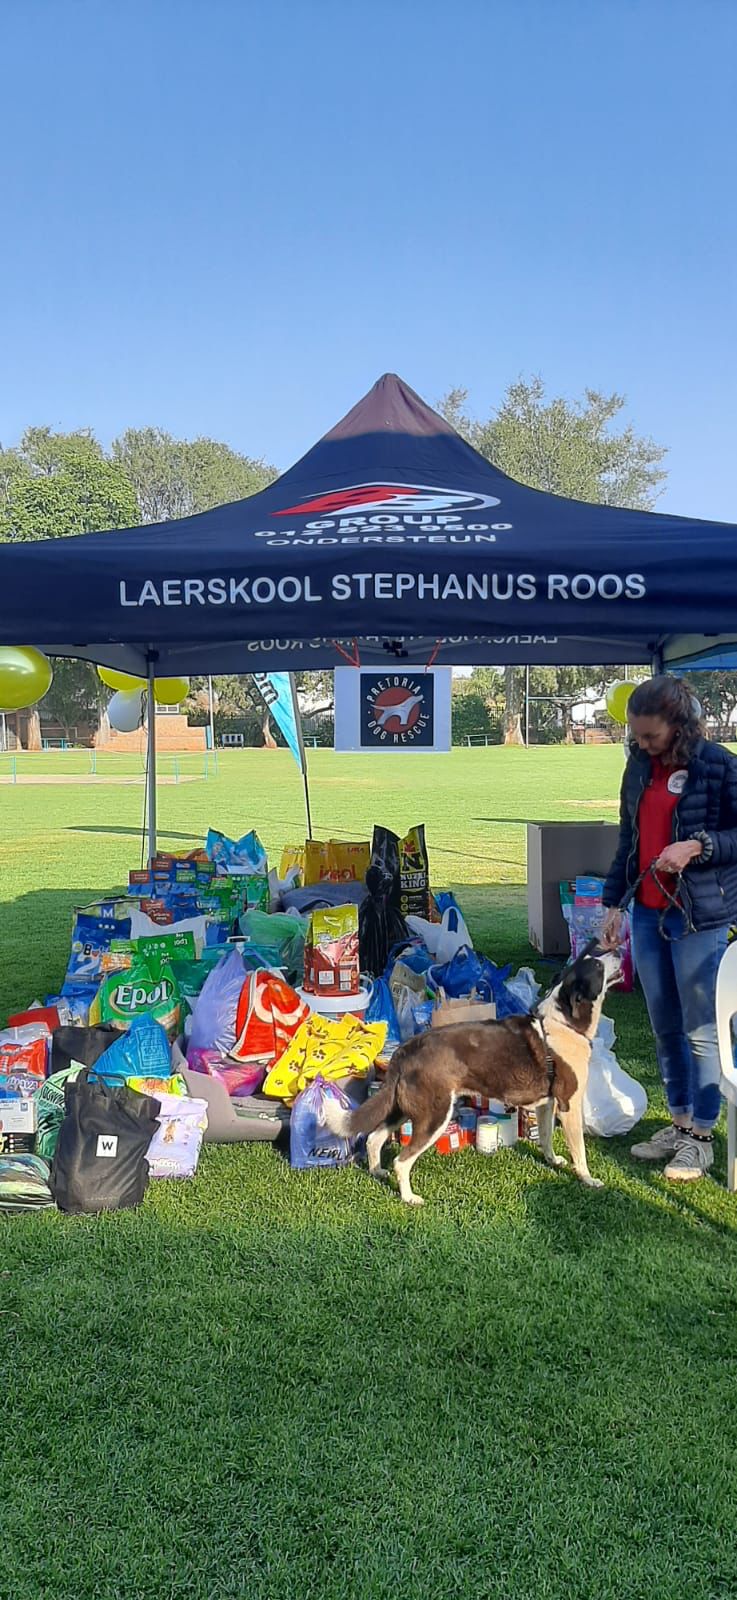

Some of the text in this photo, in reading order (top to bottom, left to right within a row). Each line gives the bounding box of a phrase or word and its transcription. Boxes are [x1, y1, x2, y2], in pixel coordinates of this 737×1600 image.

[305, 514, 462, 530] GROUP
[254, 529, 323, 537] 012
[336, 525, 406, 534] 523
[266, 534, 497, 547] ONDERSTEUN
[119, 572, 647, 607] LAERSKOOL STEPHANUS ROOS
[366, 676, 421, 703] PRETORIA
[368, 713, 430, 744] DOG RESCUE
[400, 879, 426, 889] KING
[103, 909, 114, 918] M
[116, 978, 169, 1008] Epol
[102, 1141, 114, 1151] W
